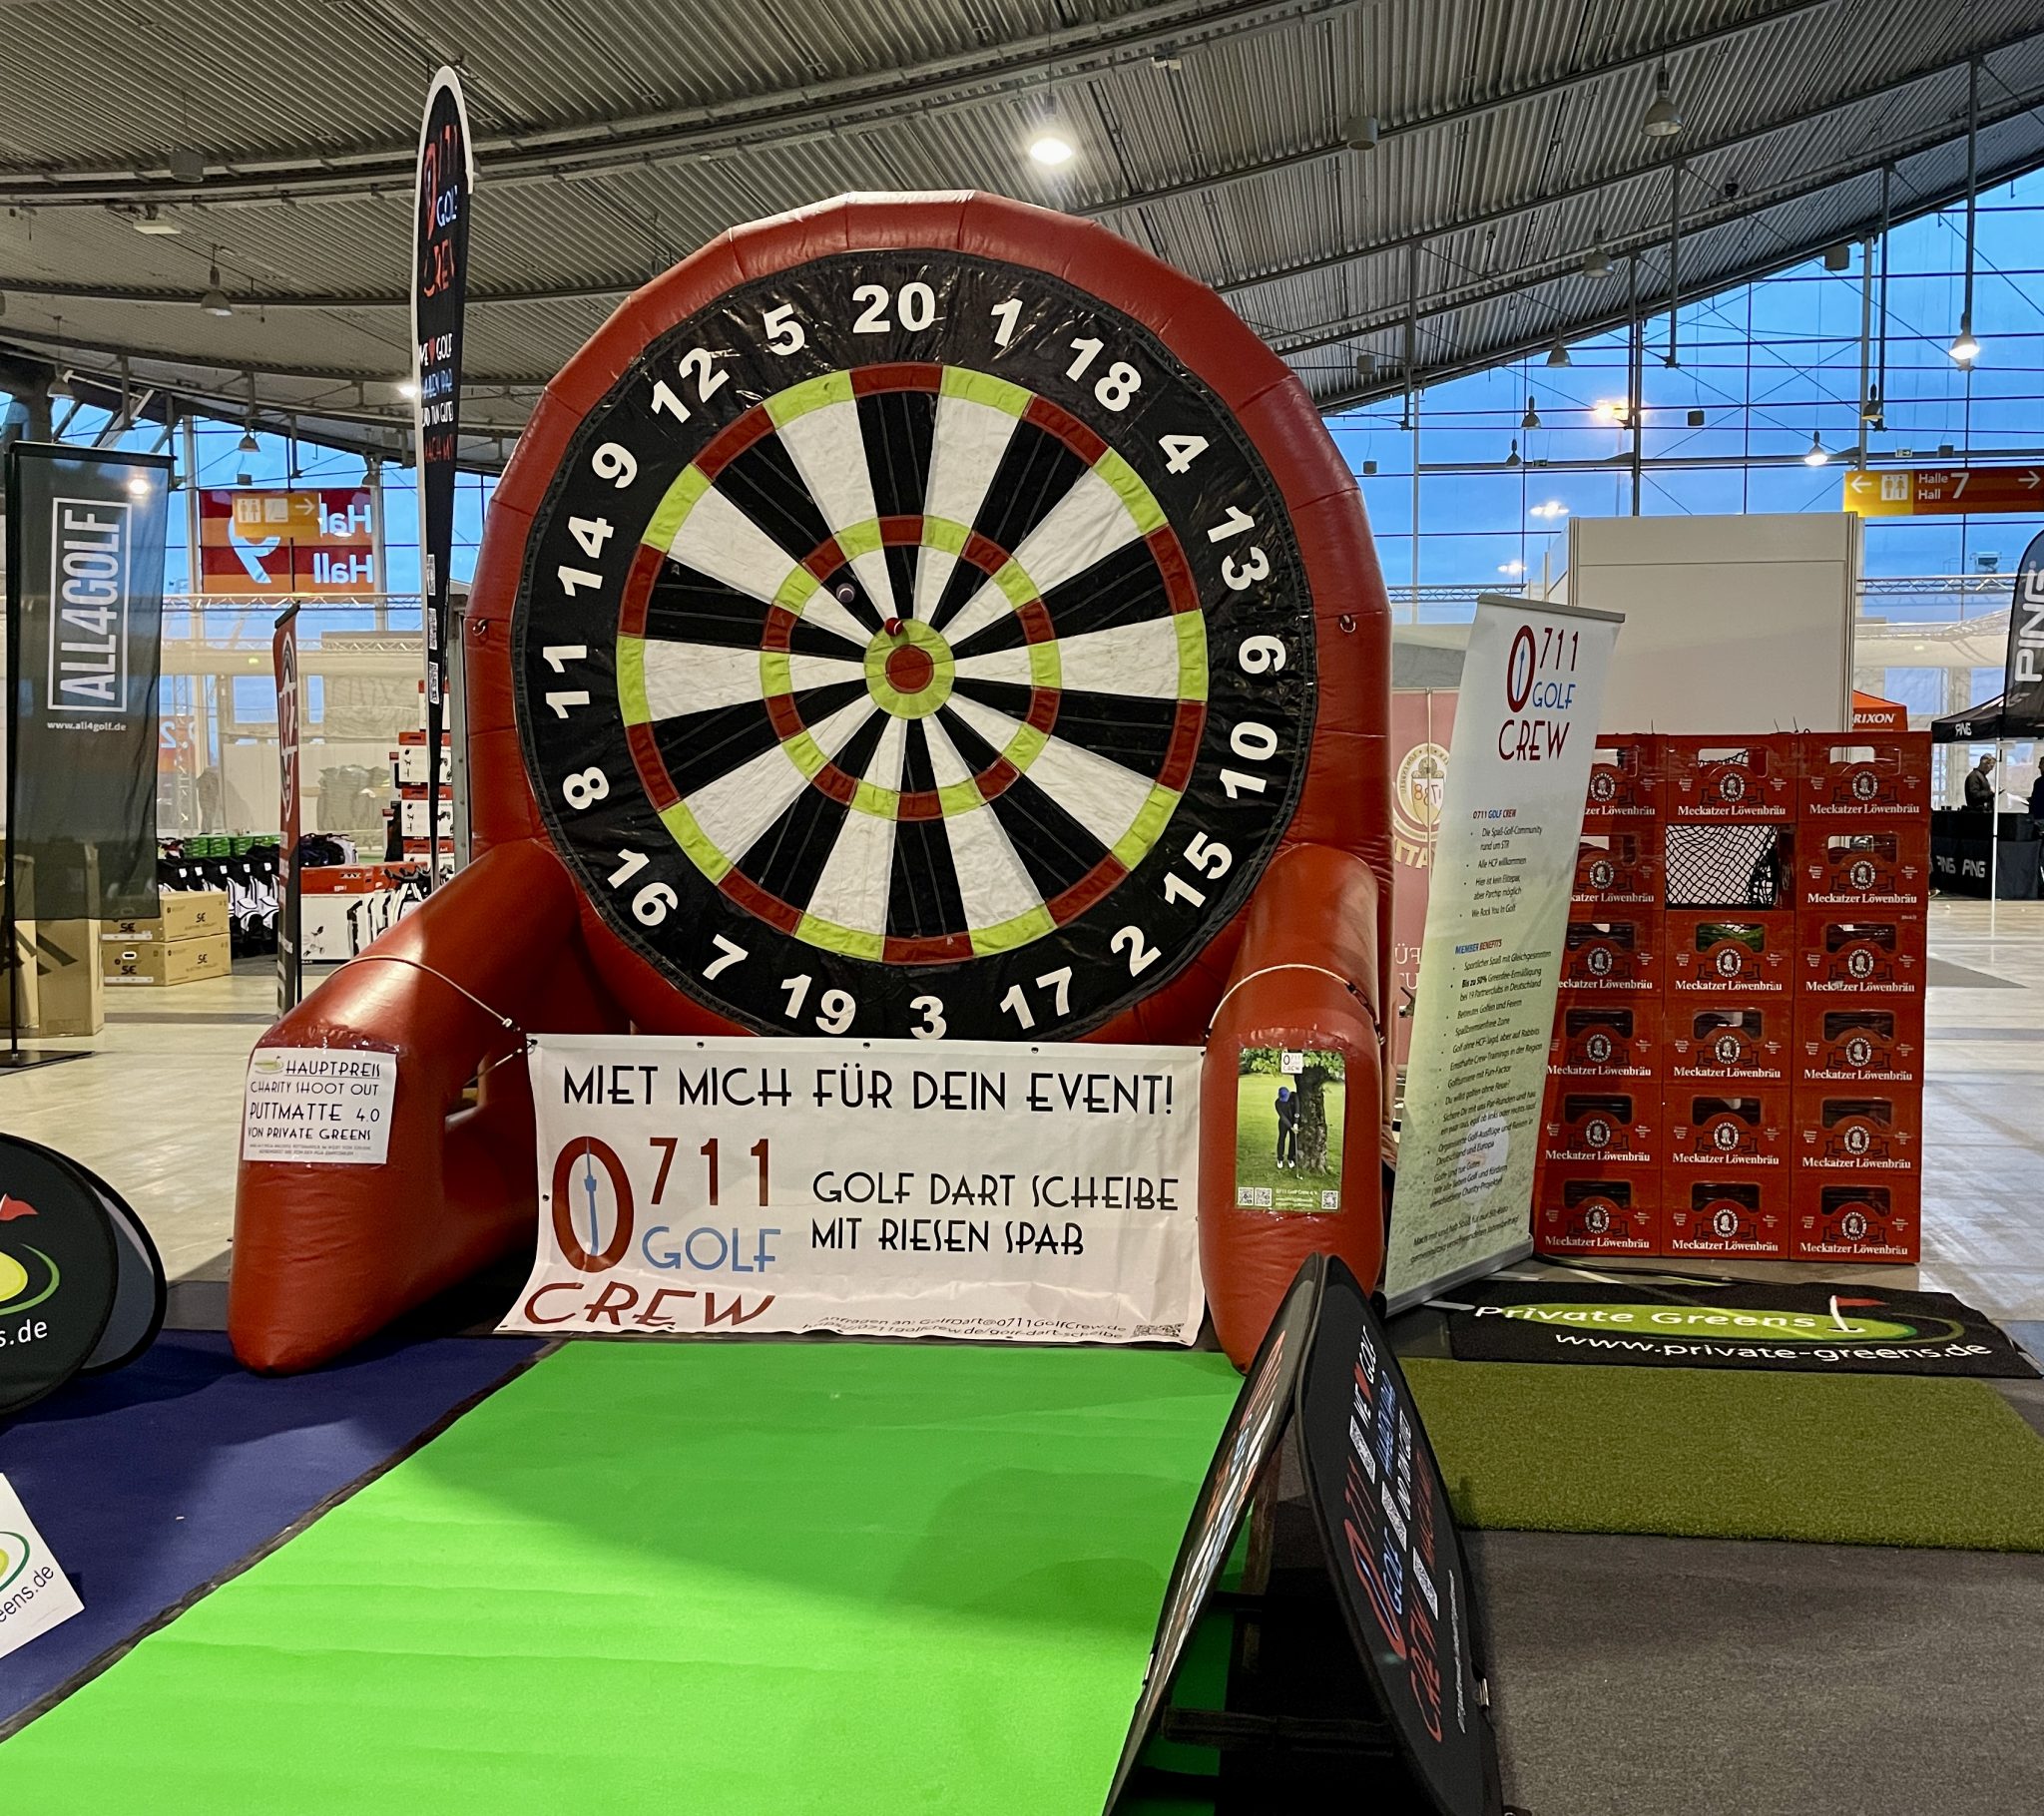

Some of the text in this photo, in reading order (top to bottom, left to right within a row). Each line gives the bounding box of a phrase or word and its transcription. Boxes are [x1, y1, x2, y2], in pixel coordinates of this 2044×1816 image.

[851, 282, 937, 331] 20
[989, 298, 1023, 347] 1
[762, 303, 805, 356] 5
[650, 347, 731, 424] 12
[1065, 337, 1142, 412] 18
[592, 442, 638, 489] 9
[1158, 434, 1210, 475] 4
[1918, 472, 1970, 499] Halle 7
[1918, 489, 1941, 500] Hall
[557, 516, 615, 597] 14
[1207, 505, 1270, 591] 13
[59, 507, 121, 701] ALL4GOLF
[2014, 569, 2044, 682] PING
[1239, 635, 1286, 675] 6
[542, 645, 591, 719] 11
[1533, 681, 1577, 709] GOLF
[47, 721, 127, 732] www.all4golf.de
[1852, 712, 1895, 724] RIXON
[1219, 721, 1278, 799] 10
[1498, 719, 1571, 761] CREW
[562, 766, 610, 810] 8
[1678, 805, 1786, 815] Meckatzer Löwenbräu
[1809, 803, 1920, 814] Meckatzer Löwenbräu
[607, 848, 679, 926] 16
[1163, 831, 1233, 908] 15
[1571, 892, 1655, 902] katzer Löwenbräu
[1807, 892, 1917, 903] Meckatzer Löwenbräu
[702, 933, 749, 981] 7
[1110, 925, 1162, 977] 2
[1455, 938, 1502, 954] MEMBER BENEFITS
[780, 974, 856, 1035] 19
[999, 966, 1073, 1030] 17
[1558, 979, 1653, 990] eckatzer Löwenbräu
[1675, 980, 1783, 991] Meckatzer Löwenbräu
[909, 996, 948, 1040] 3
[251, 1082, 379, 1096] CHARITY SHOOT OUT
[285, 1060, 380, 1078] HAUPTPREIS
[564, 1062, 1173, 1116] MIET MICH FÜR DEIN EVENT!
[1546, 1065, 1652, 1077] Meckatzer Löwenbräu
[1674, 1067, 1781, 1079] Meckatzer Löwenbräu
[1803, 1070, 1913, 1081] Meckatzer Löwenbräu
[250, 1102, 380, 1124] PUTTMATTE 4.0
[266, 1128, 313, 1139] PRIVATE
[319, 1129, 371, 1140] GREENS
[1545, 1150, 1651, 1162] Meckatzer Löwenbräu
[1673, 1152, 1780, 1165] Meckatzer Löwenbräu
[1802, 1157, 1911, 1169] Meckatzer Löwenbräu
[551, 1135, 770, 1272] 0711
[812, 1170, 1179, 1211] GOLF DART SCHEIBE
[642, 1225, 781, 1272] GOLF
[811, 1216, 862, 1250] MIT
[877, 1217, 989, 1253] RIESEN
[1545, 1236, 1650, 1248] Meckatzer Löwenbräu
[1672, 1239, 1779, 1252] Meckatzer Löwenbräu
[1799, 1243, 1908, 1255] Meckatzer Löwenbräu
[522, 1280, 775, 1327] CREW
[1474, 1304, 1816, 1329] Private Greens
[1555, 1333, 1992, 1362] www.private-greens.de
[1383, 1527, 1403, 1614] GOLF
